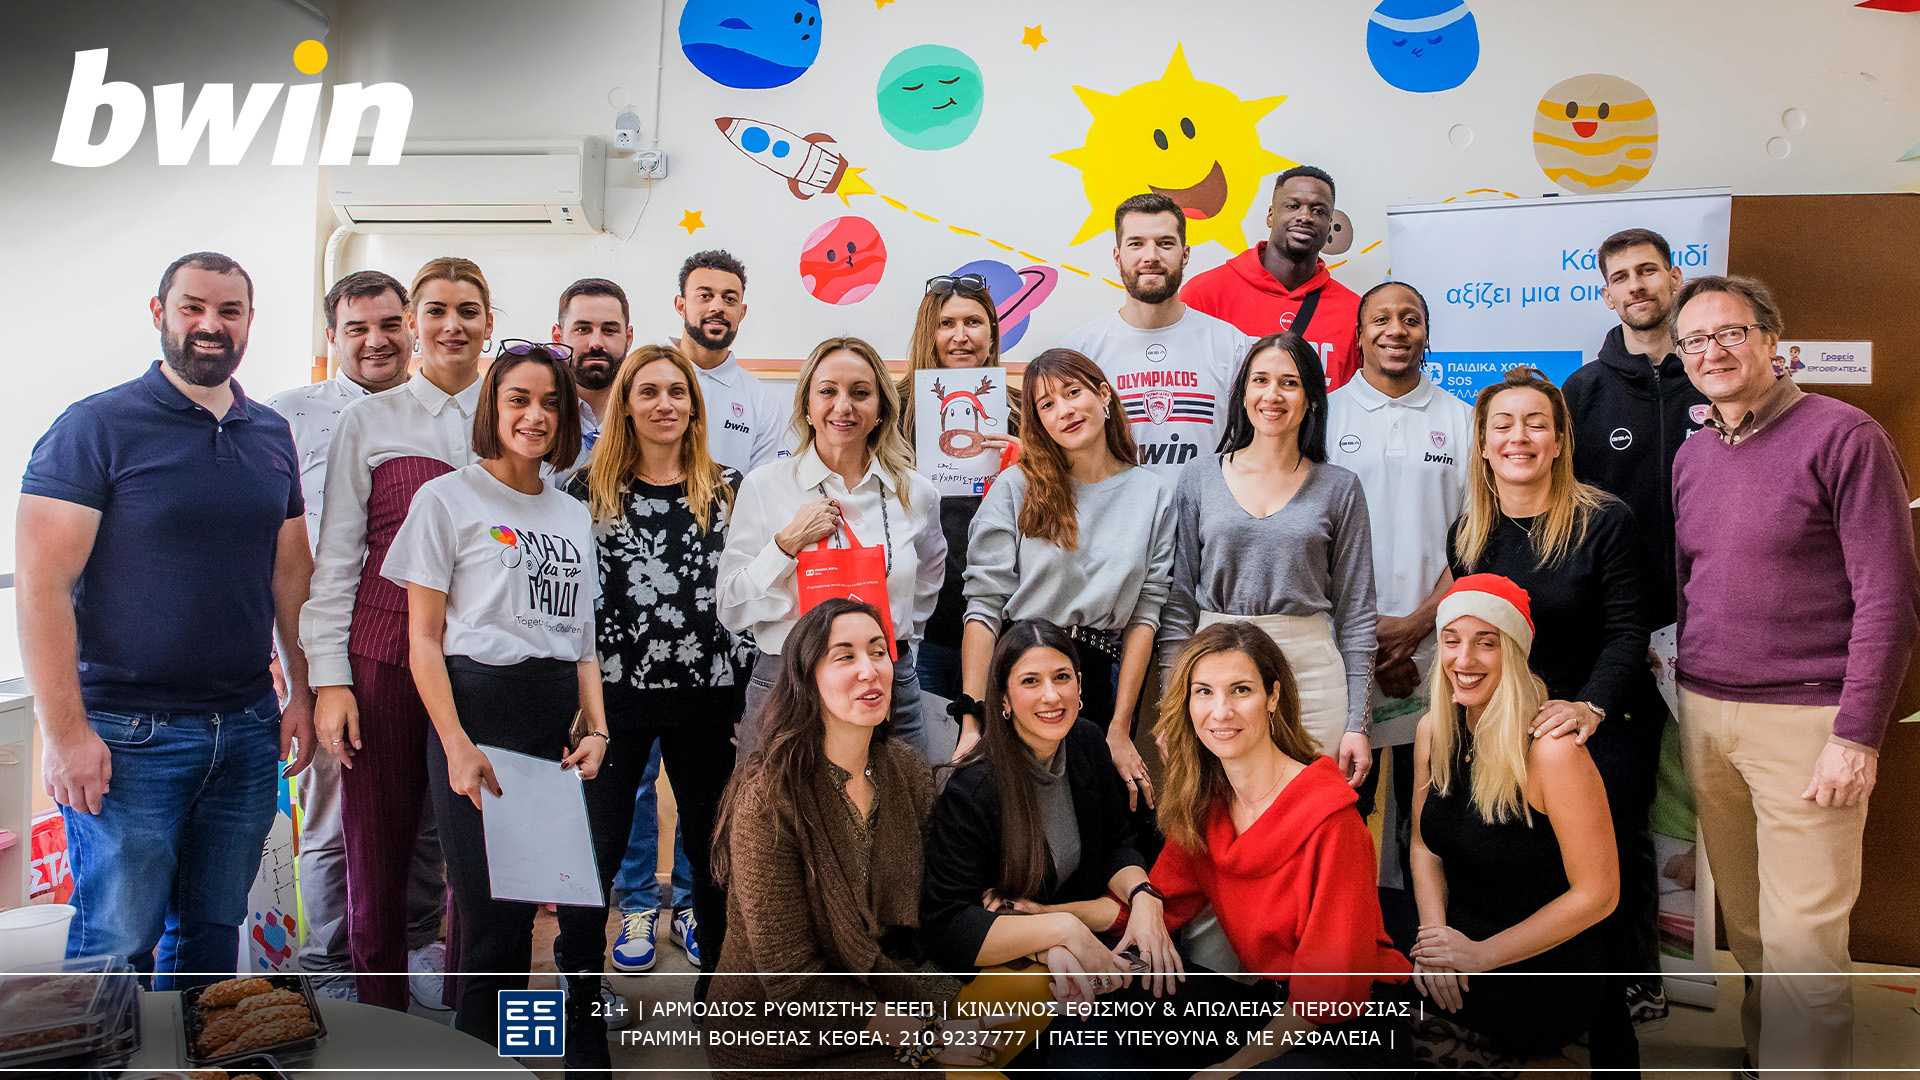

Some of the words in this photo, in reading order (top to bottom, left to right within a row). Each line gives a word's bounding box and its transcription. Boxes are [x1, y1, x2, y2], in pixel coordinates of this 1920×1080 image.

[1562, 248, 1598, 271] Κά
[1671, 244, 1709, 267] ιδί
[1446, 282, 1511, 309] αξίζει
[1522, 285, 1560, 304] μια
[1570, 284, 1603, 302] οικ
[1821, 352, 1854, 362] Γραφείο
[1447, 362, 1498, 373] ΠΑΙΔΙΚΑ
[1117, 370, 1198, 390] OLYMPIACOS
[1447, 376, 1473, 386] SOS
[723, 419, 750, 434] bwin
[1138, 433, 1198, 465] win
[1423, 451, 1454, 466] bwin
[515, 528, 581, 564] ΜΑΖΙ
[563, 567, 582, 578] το
[528, 574, 579, 618] ΠΑΙΔΙ
